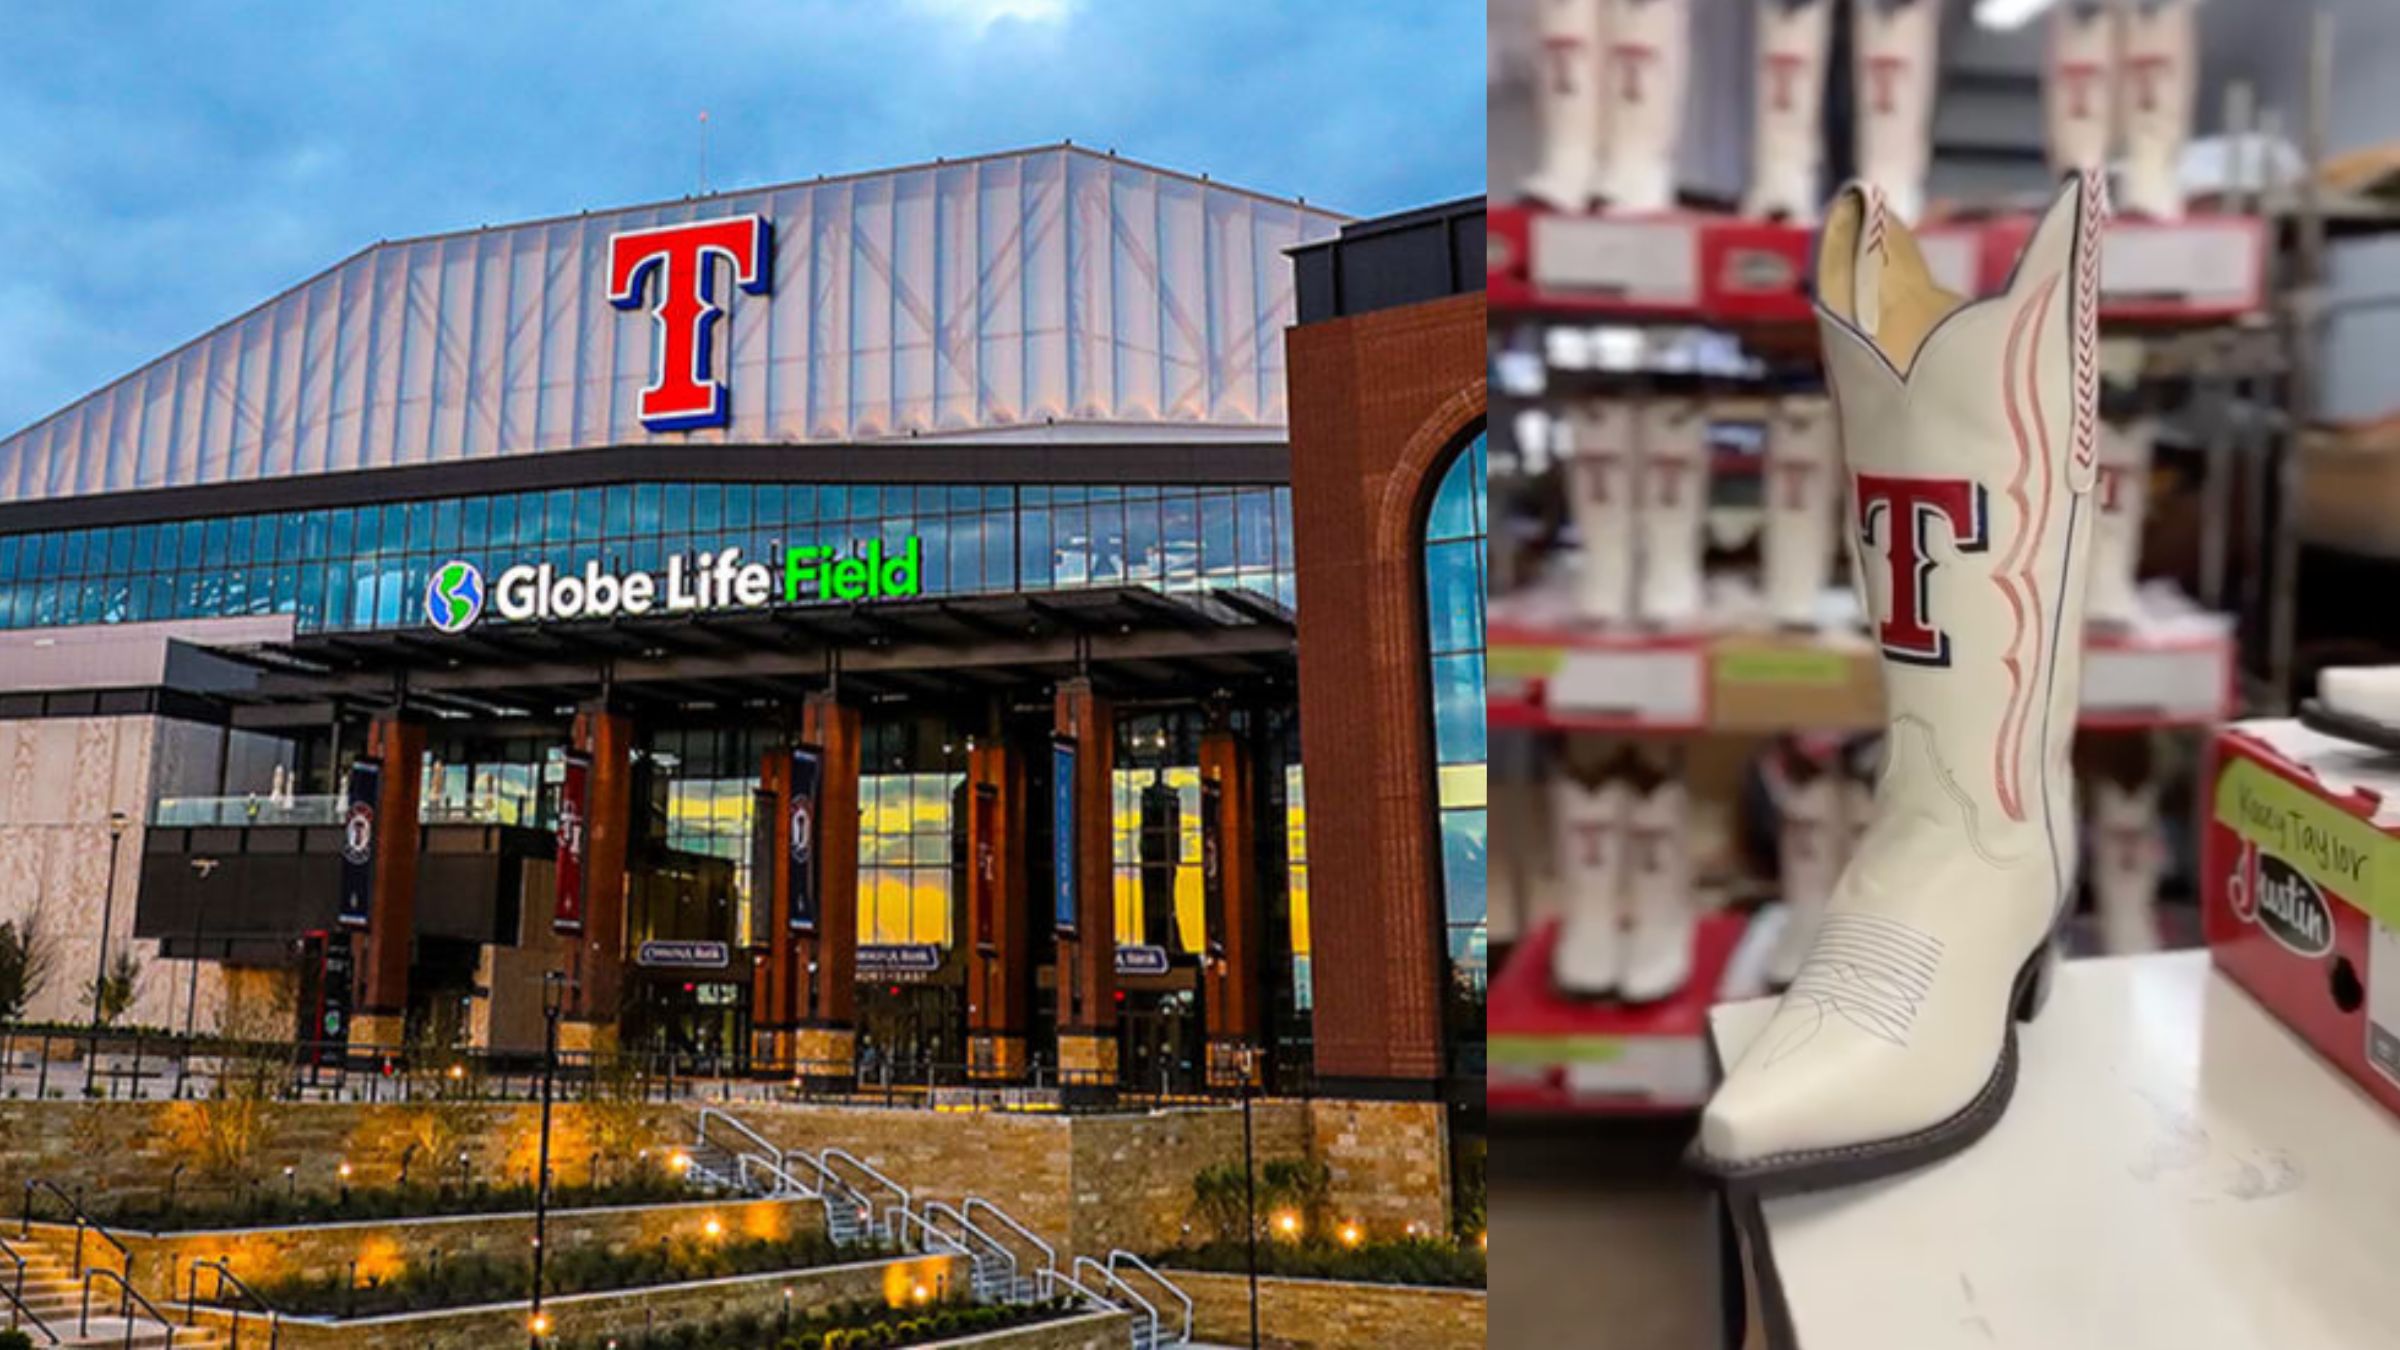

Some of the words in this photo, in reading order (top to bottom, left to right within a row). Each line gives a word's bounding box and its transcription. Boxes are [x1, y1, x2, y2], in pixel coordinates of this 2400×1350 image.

[607, 213, 773, 432] T
[495, 561, 654, 620] Globe
[667, 547, 771, 613] Life
[783, 536, 921, 602] Field
[1856, 473, 1989, 667] T
[2228, 836, 2325, 945] Justin
[2287, 809, 2369, 882] Taylor
